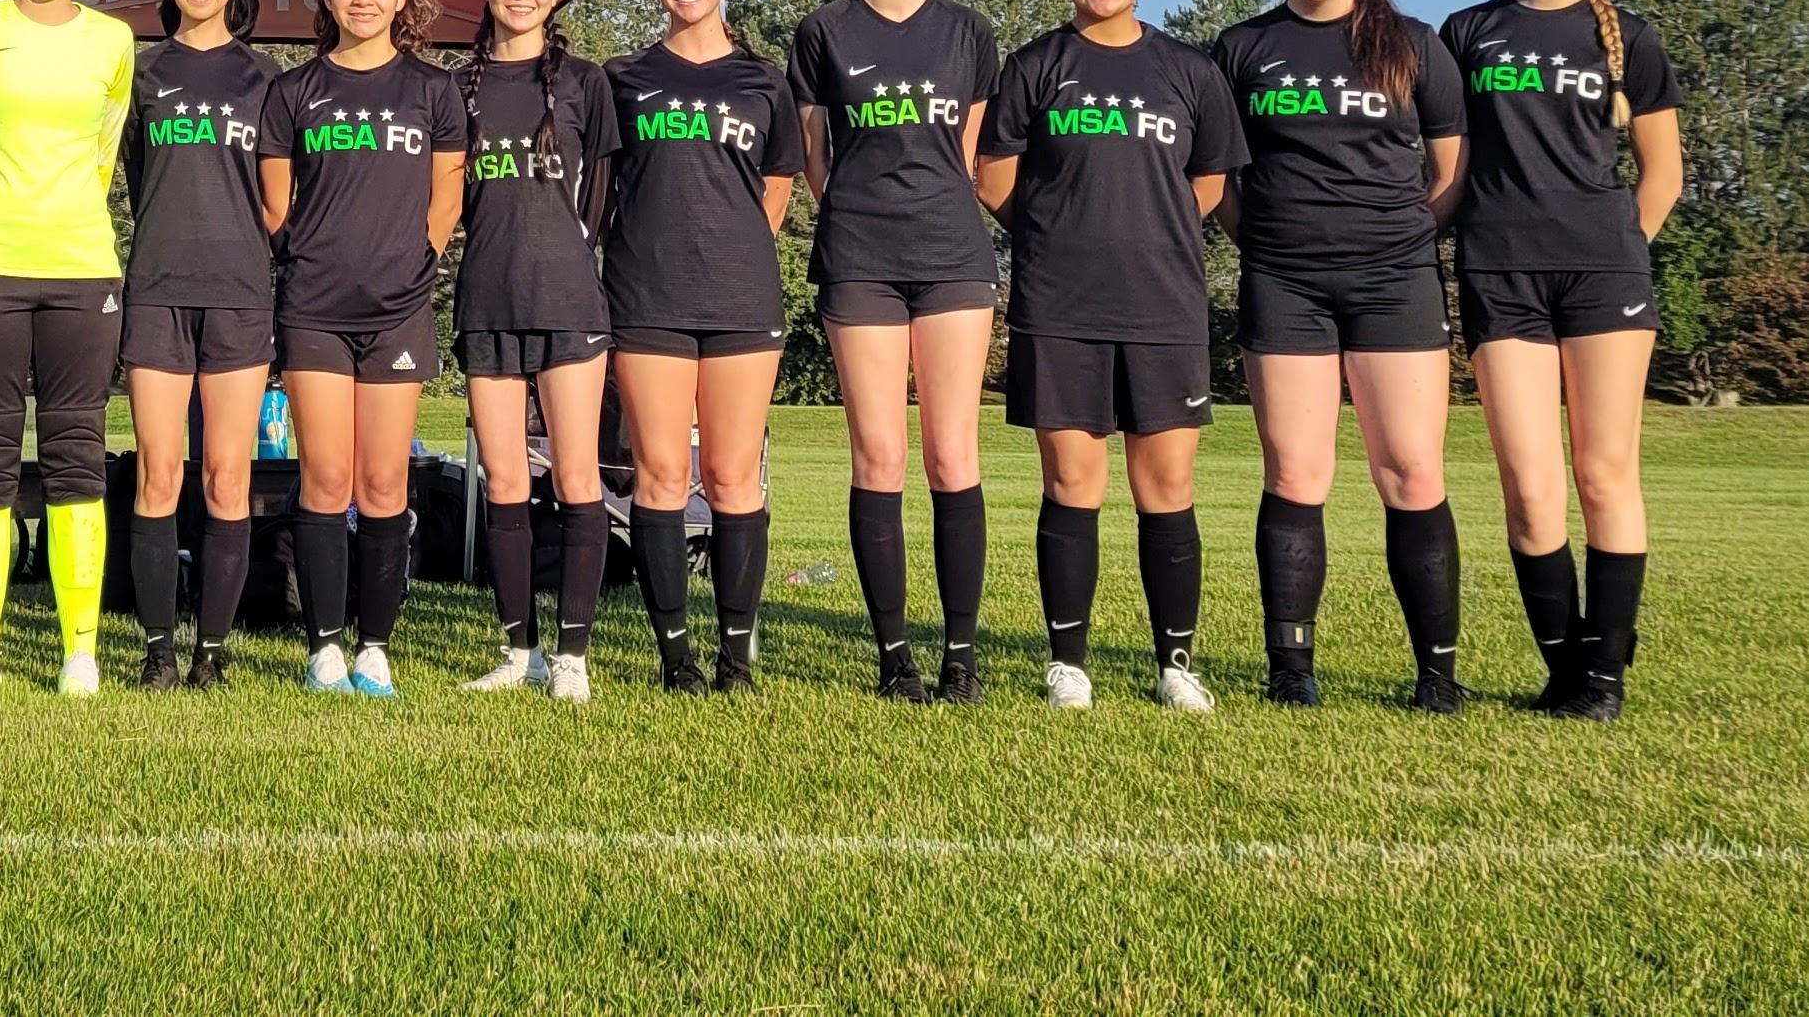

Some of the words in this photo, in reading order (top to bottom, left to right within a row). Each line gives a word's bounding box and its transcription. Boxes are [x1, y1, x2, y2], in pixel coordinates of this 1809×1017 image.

[1471, 66, 1545, 95] MSA
[1554, 68, 1603, 100] FC
[845, 98, 921, 128] MSA
[928, 98, 959, 126] FC
[1249, 89, 1329, 116] MSA
[1339, 90, 1388, 118] FC
[149, 118, 217, 147] MSA
[224, 120, 256, 152] FC
[304, 124, 378, 154] MSA
[386, 125, 423, 155] FC
[637, 111, 711, 141] MSA
[719, 116, 756, 151] FC
[1049, 109, 1129, 136] MSA
[1137, 112, 1177, 145] FC
